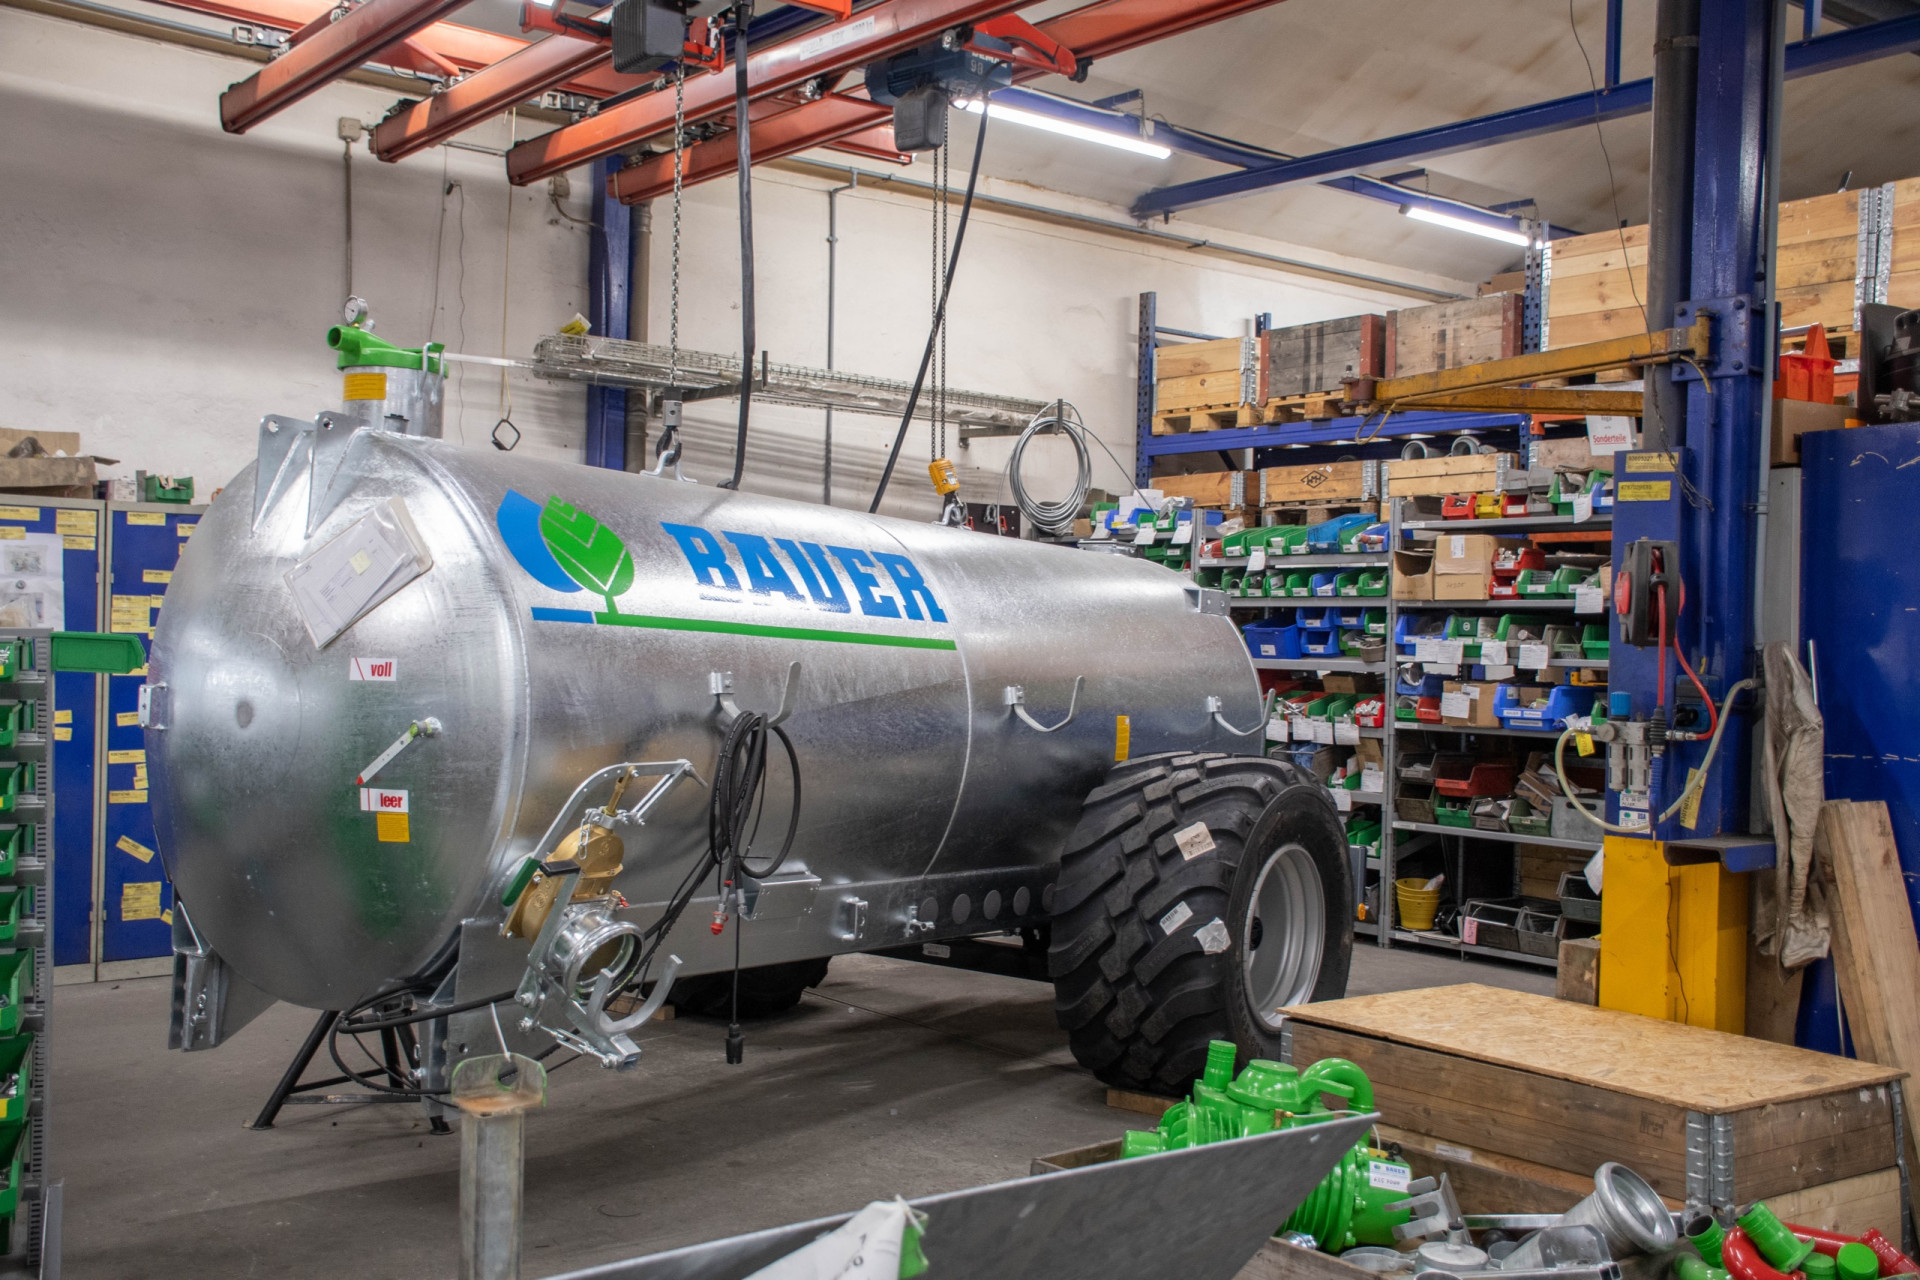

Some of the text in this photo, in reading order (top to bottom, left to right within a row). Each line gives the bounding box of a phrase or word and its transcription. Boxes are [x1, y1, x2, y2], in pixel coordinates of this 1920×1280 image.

[1592, 434, 1627, 443] Sonderteile
[660, 522, 948, 623] BAUER
[370, 661, 392, 677] voll
[379, 792, 403, 808] leer
